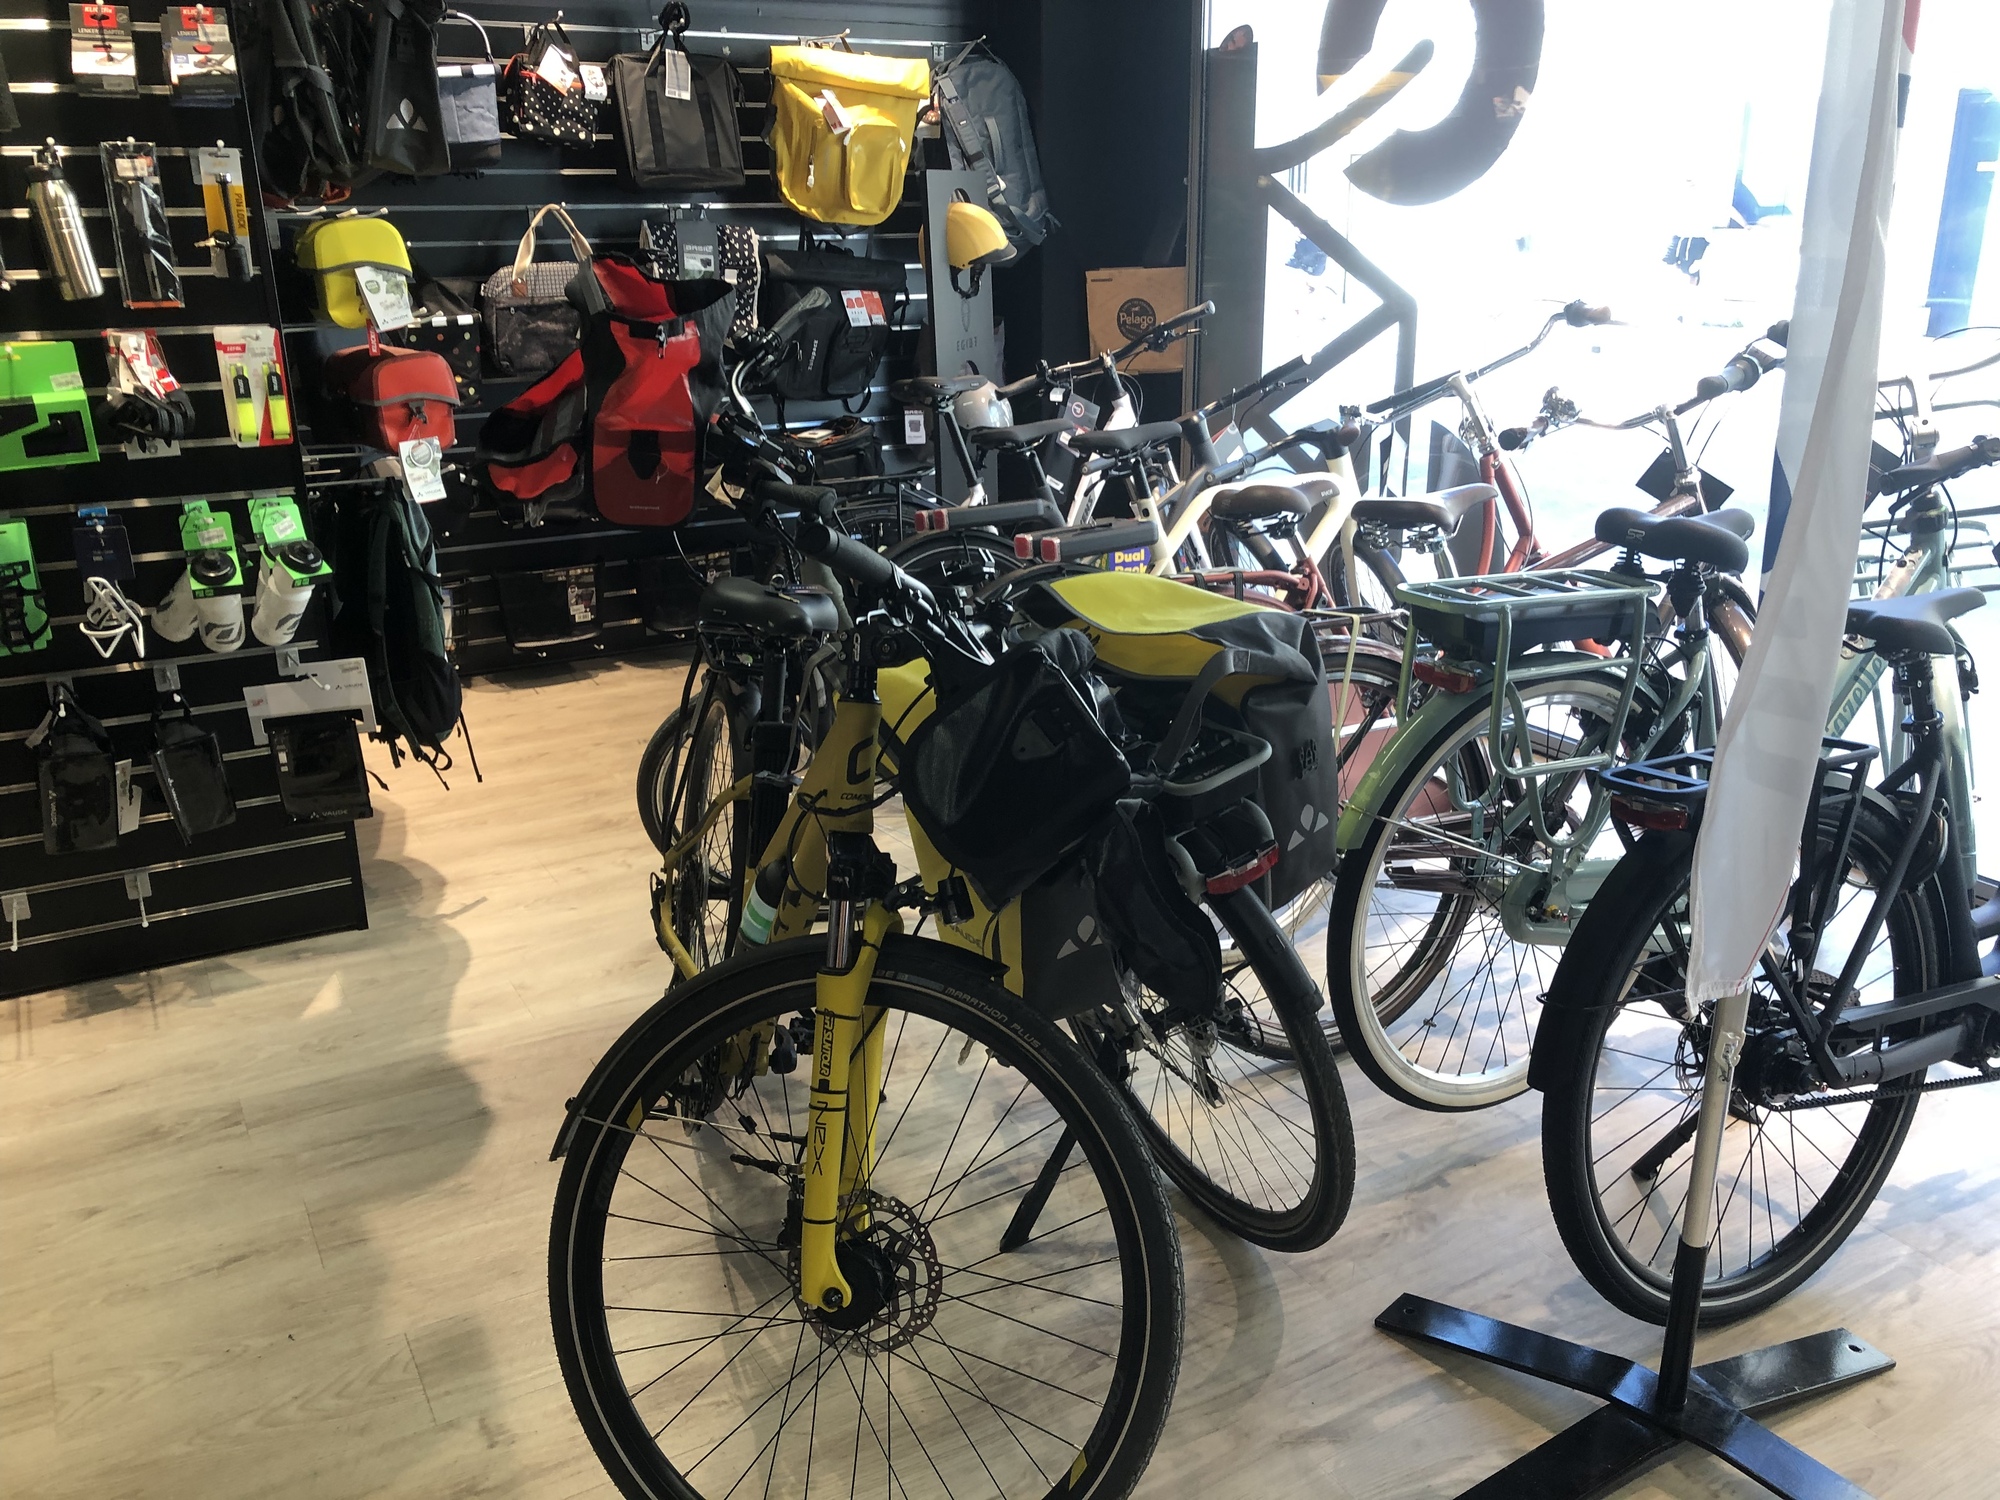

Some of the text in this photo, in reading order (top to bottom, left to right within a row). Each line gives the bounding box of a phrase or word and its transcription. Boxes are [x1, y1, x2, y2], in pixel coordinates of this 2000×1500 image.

[84, 6, 113, 14] KLICfix
[234, 193, 247, 229] PIN LOCK
[1120, 311, 1154, 330] Pelago
[1114, 548, 1145, 564] Dual
[1826, 656, 1884, 740] azelle
[321, 808, 349, 817] VAUDE
[946, 986, 1042, 1049] MARATHON PLUS
[819, 1029, 834, 1077] SUNTOUR
